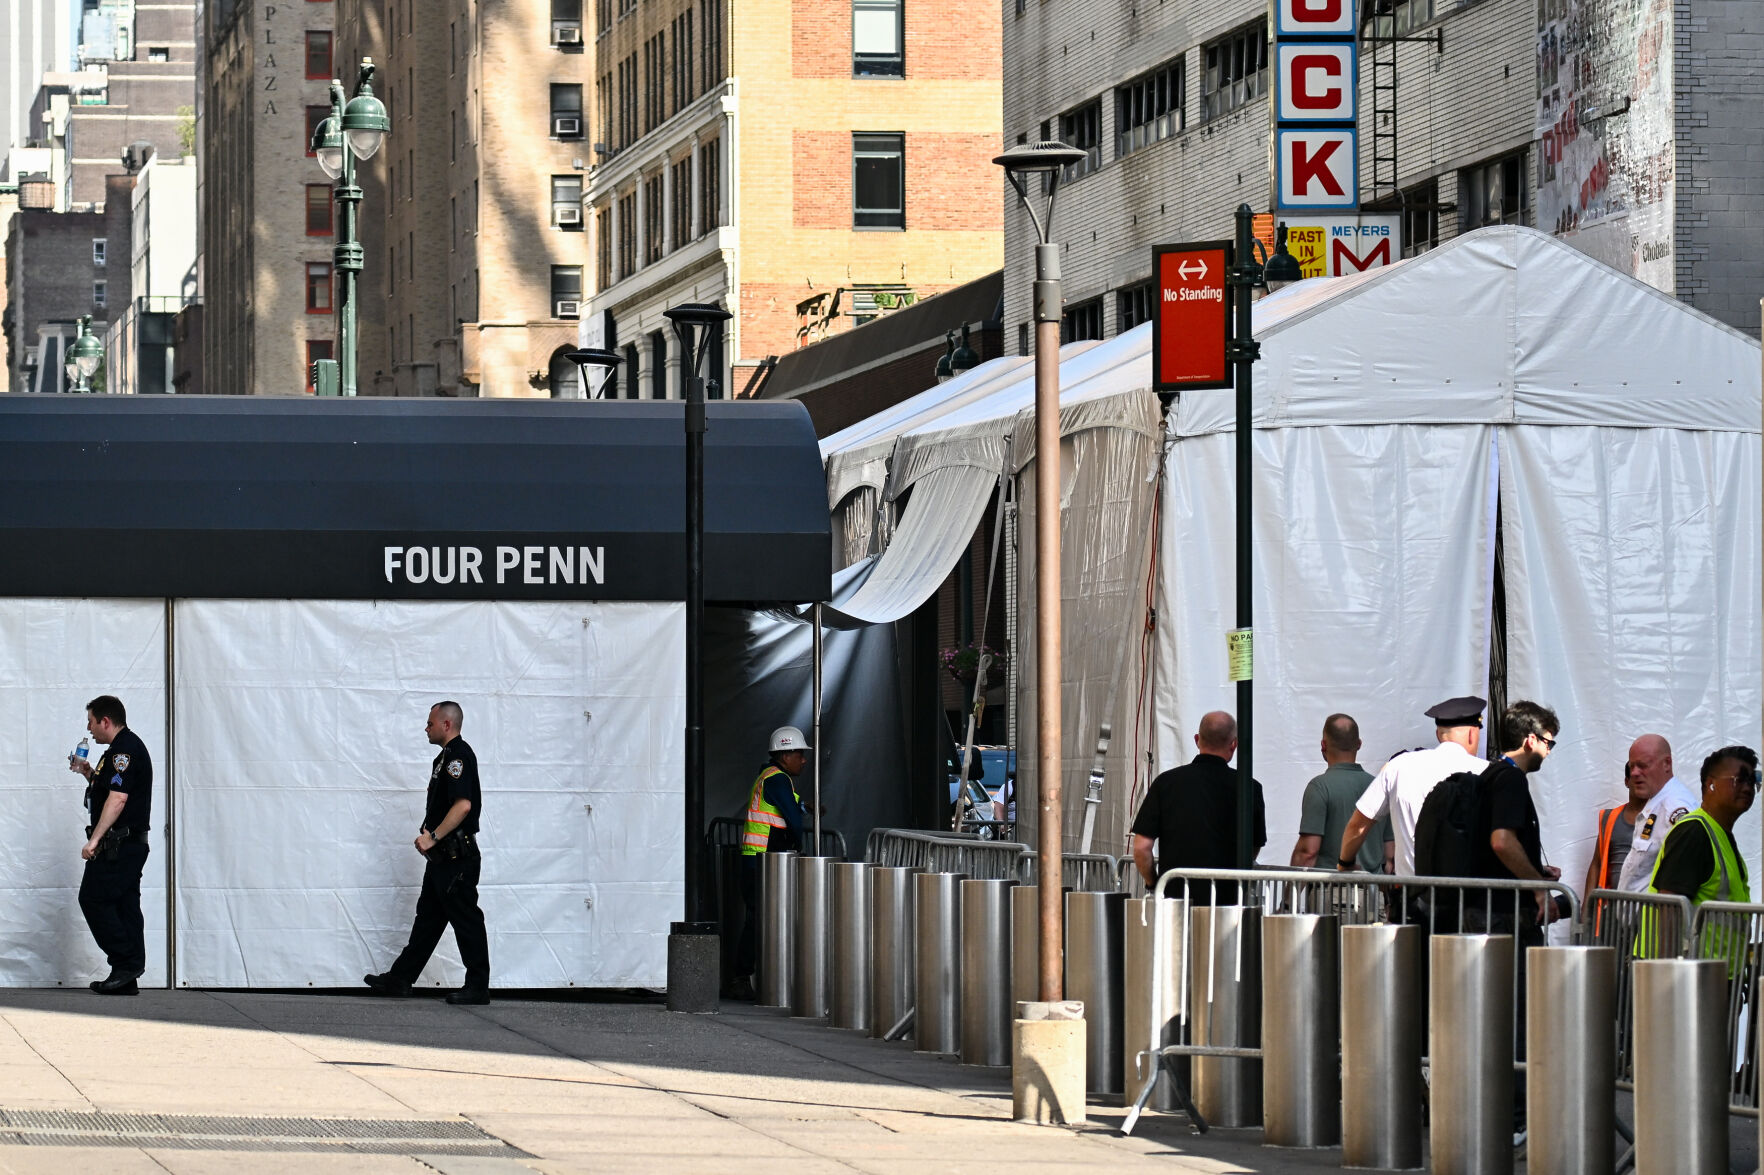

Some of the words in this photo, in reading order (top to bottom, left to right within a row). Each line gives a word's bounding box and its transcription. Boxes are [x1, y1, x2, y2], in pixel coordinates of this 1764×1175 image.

[264, 6, 277, 115] PLAZA
[1332, 225, 1390, 236] MEYERS
[1290, 231, 1324, 243] FAST
[1300, 245, 1314, 257] IN
[1303, 268, 1323, 278] UT
[1163, 288, 1178, 302] No
[1179, 285, 1223, 303] Standing
[384, 546, 484, 584] FOUR
[496, 546, 605, 584] PENN
